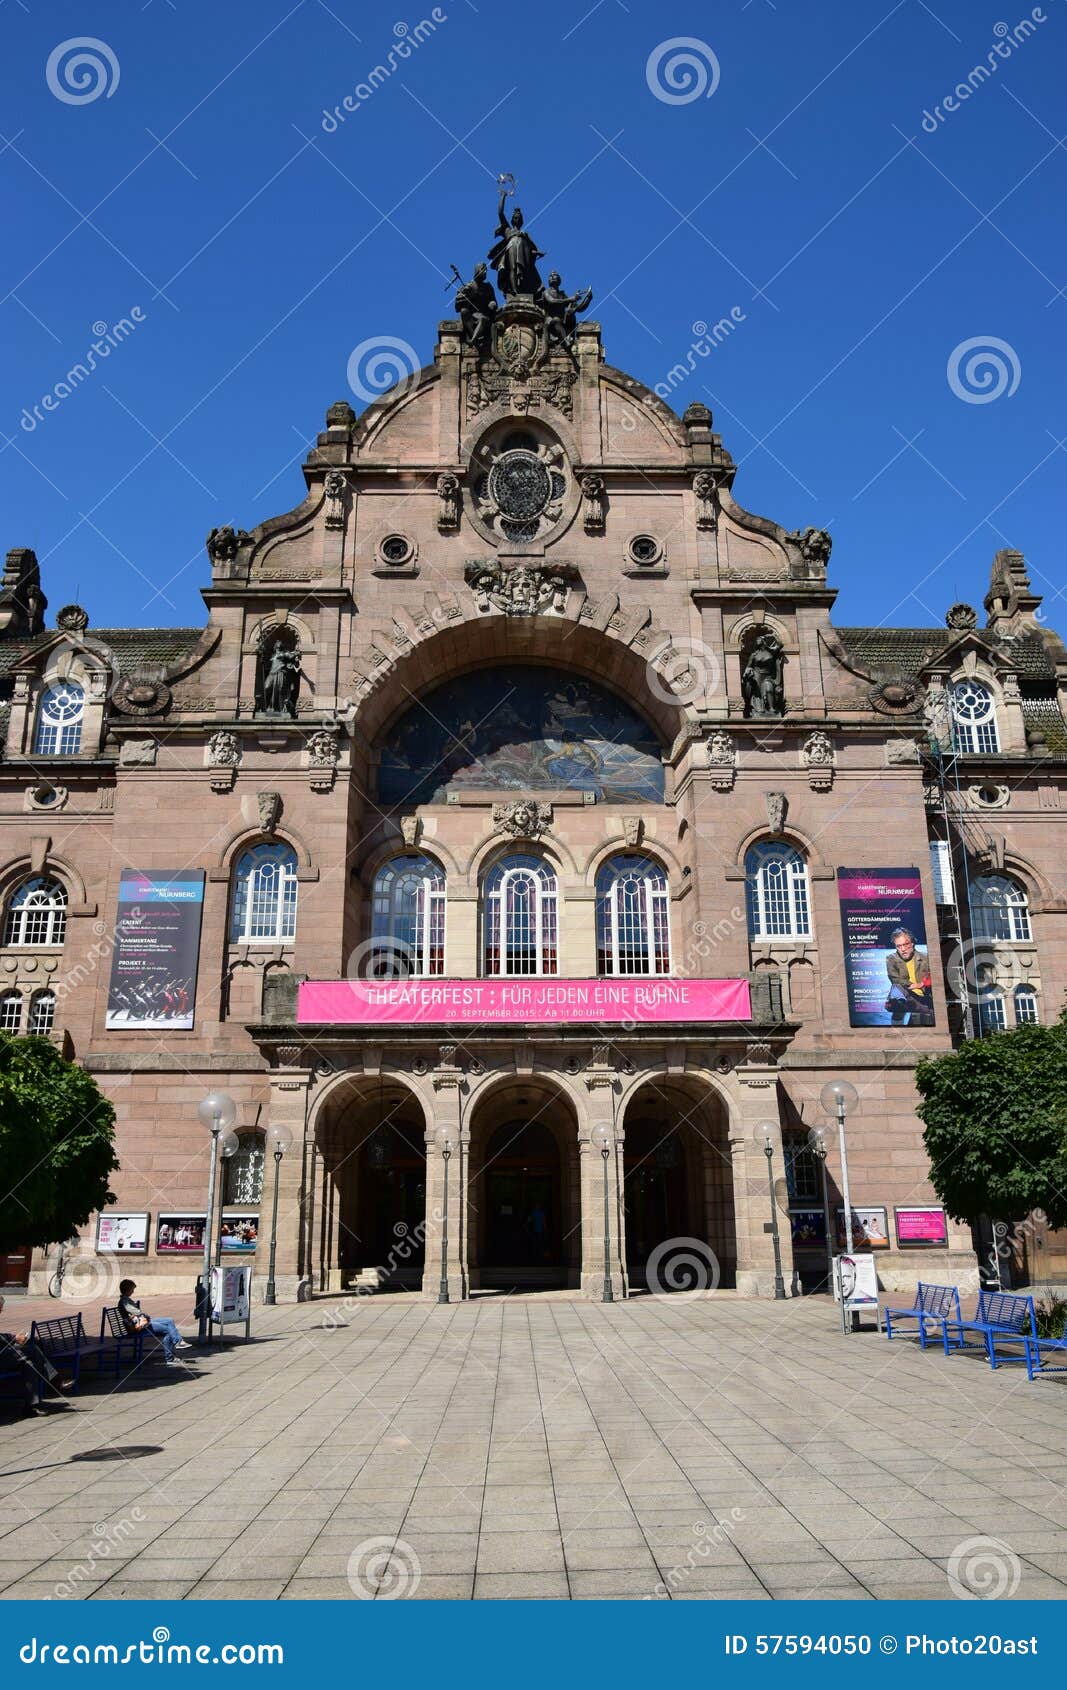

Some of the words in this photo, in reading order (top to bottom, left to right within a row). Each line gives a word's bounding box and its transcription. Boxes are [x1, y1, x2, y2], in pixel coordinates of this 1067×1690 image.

[366, 988, 484, 1005] THEATERFEST
[502, 984, 531, 1004] FÜR
[537, 987, 588, 1004] JEDEN
[595, 987, 628, 1004] EINE
[635, 984, 689, 1004] BÜHNE
[545, 1009, 557, 1017] AB
[586, 1009, 605, 1017] UHR
